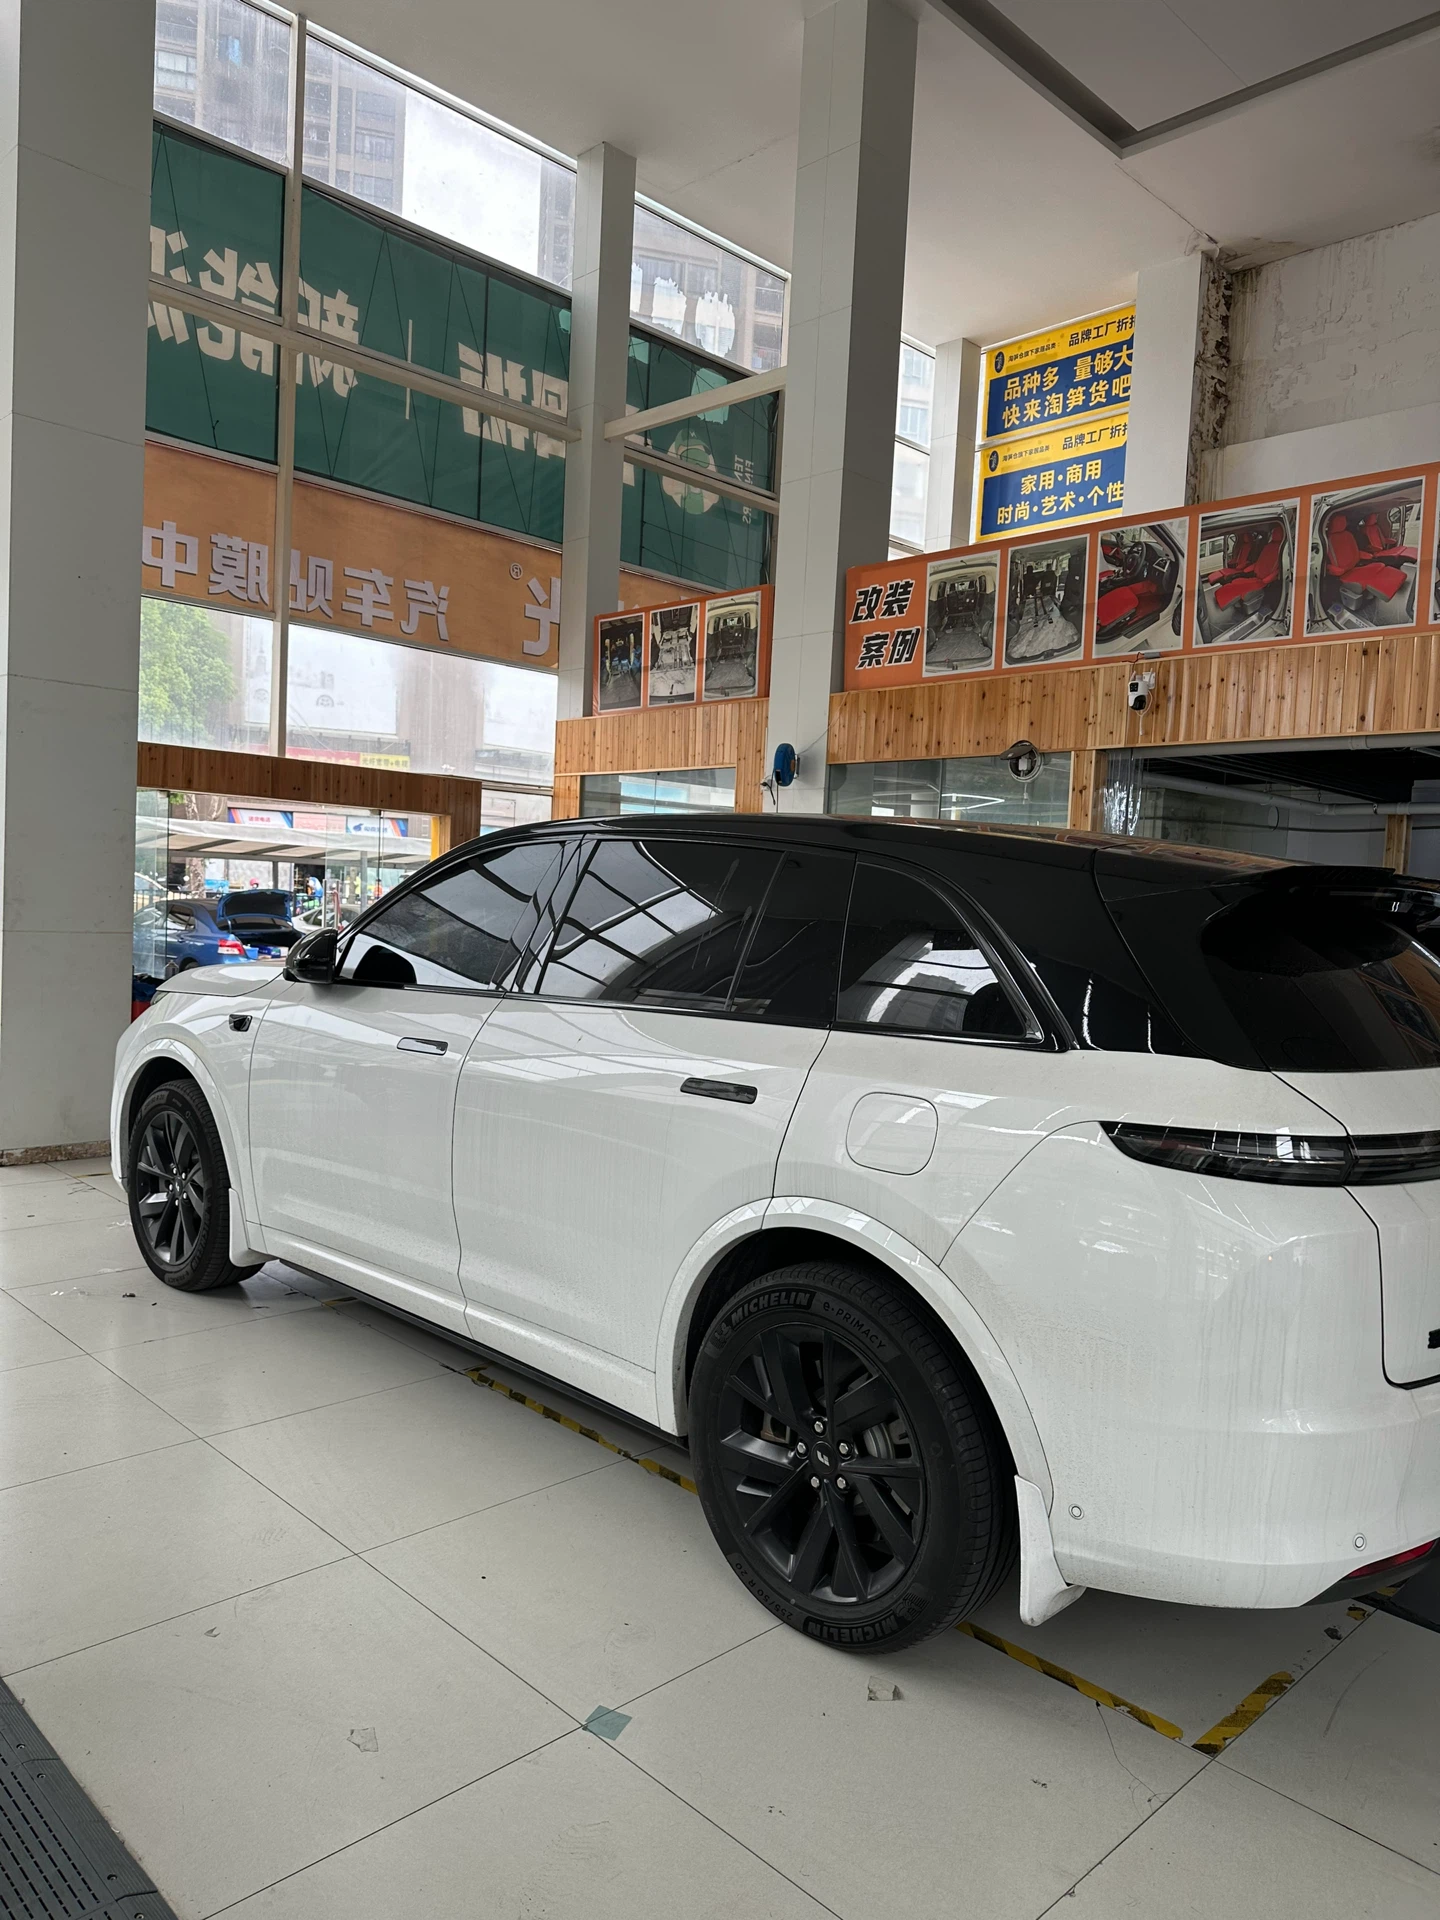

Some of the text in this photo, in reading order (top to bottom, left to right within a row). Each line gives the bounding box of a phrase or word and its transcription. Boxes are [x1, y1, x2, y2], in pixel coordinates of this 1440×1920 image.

[1004, 345, 1133, 402] 品种多 量够大
[1002, 373, 1131, 429] 快来淘笋货吧
[849, 579, 915, 624] 改装
[855, 626, 921, 670] 案例
[731, 1291, 811, 1325] MICHELIN
[735, 1562, 747, 1576] 20
[757, 1588, 793, 1620] 255/50
[807, 1615, 899, 1643] MICHELIN
